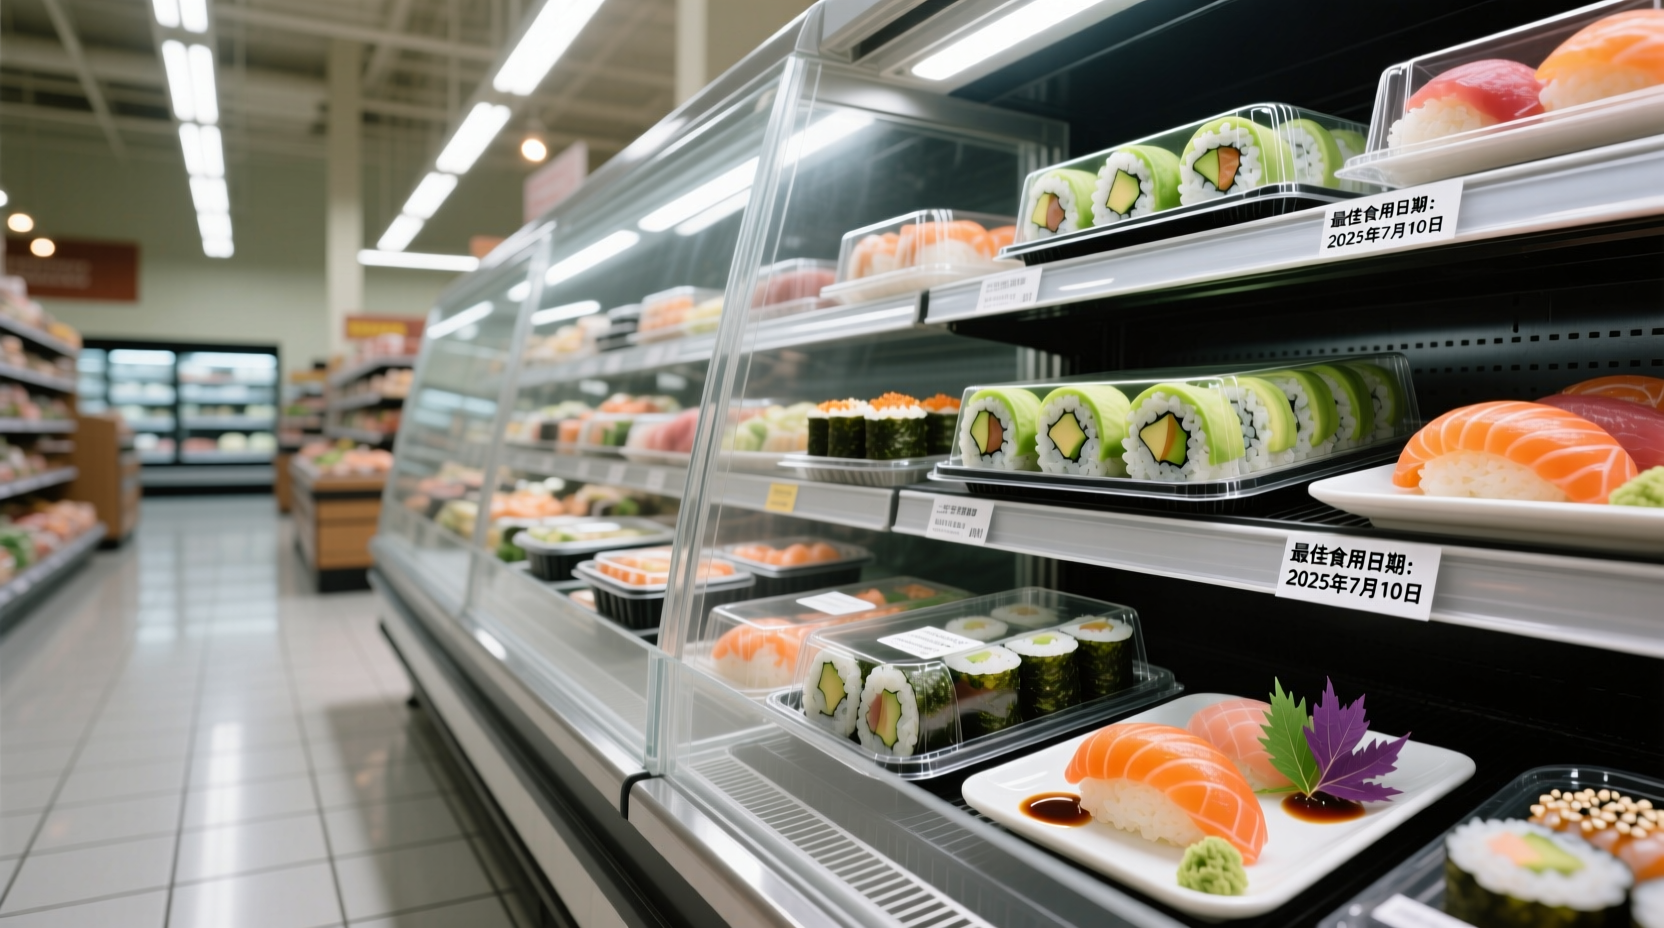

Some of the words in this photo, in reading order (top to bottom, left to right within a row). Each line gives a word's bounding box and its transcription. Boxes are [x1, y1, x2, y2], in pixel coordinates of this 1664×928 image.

[1327, 216, 1443, 248] 2025年7月10日
[1286, 569, 1422, 604] 2025年7月10日
